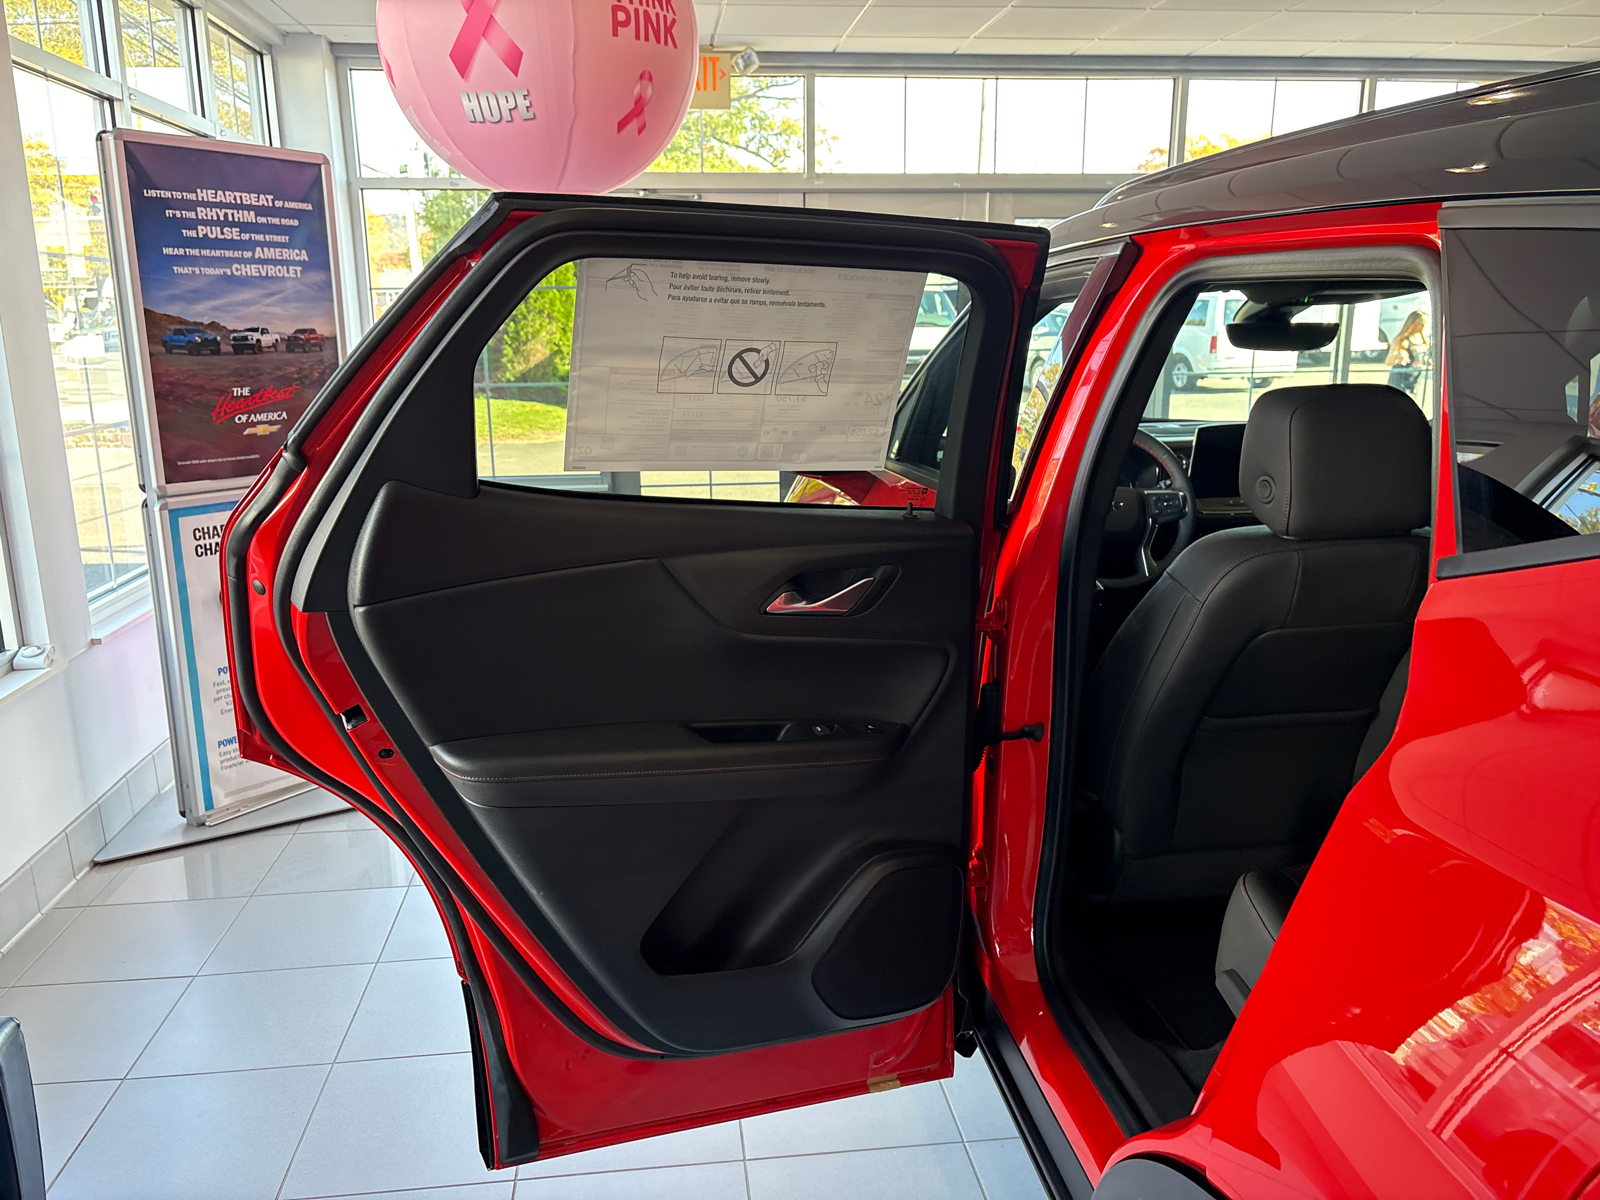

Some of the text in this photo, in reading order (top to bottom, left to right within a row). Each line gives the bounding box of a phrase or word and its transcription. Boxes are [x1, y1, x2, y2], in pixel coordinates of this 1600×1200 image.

[611, 4, 678, 49] PINK
[460, 88, 536, 124] HOPE
[144, 188, 313, 210] LISTEN TO THE HEARTBEAT OF AMERICA
[166, 207, 299, 226] IT'S THE RHYTHM ON THE ROAD
[181, 229, 197, 237] THE
[197, 225, 240, 240] PULSE
[251, 234, 265, 242] THE
[265, 234, 289, 243] STREET
[163, 247, 185, 256] HEAR
[185, 248, 200, 256] THE
[201, 249, 242, 258] HEARTBEAT
[255, 247, 309, 261] AMERICA
[173, 264, 302, 278] THAT'S TODAY'S CHEVROLET
[679, 272, 691, 280] help
[709, 274, 729, 282] tearing,
[752, 277, 771, 285] slowly.
[716, 285, 743, 294] déchirure,
[232, 387, 251, 397] THE
[210, 385, 300, 421] Heartbeat
[235, 411, 288, 423] OF AMERICA
